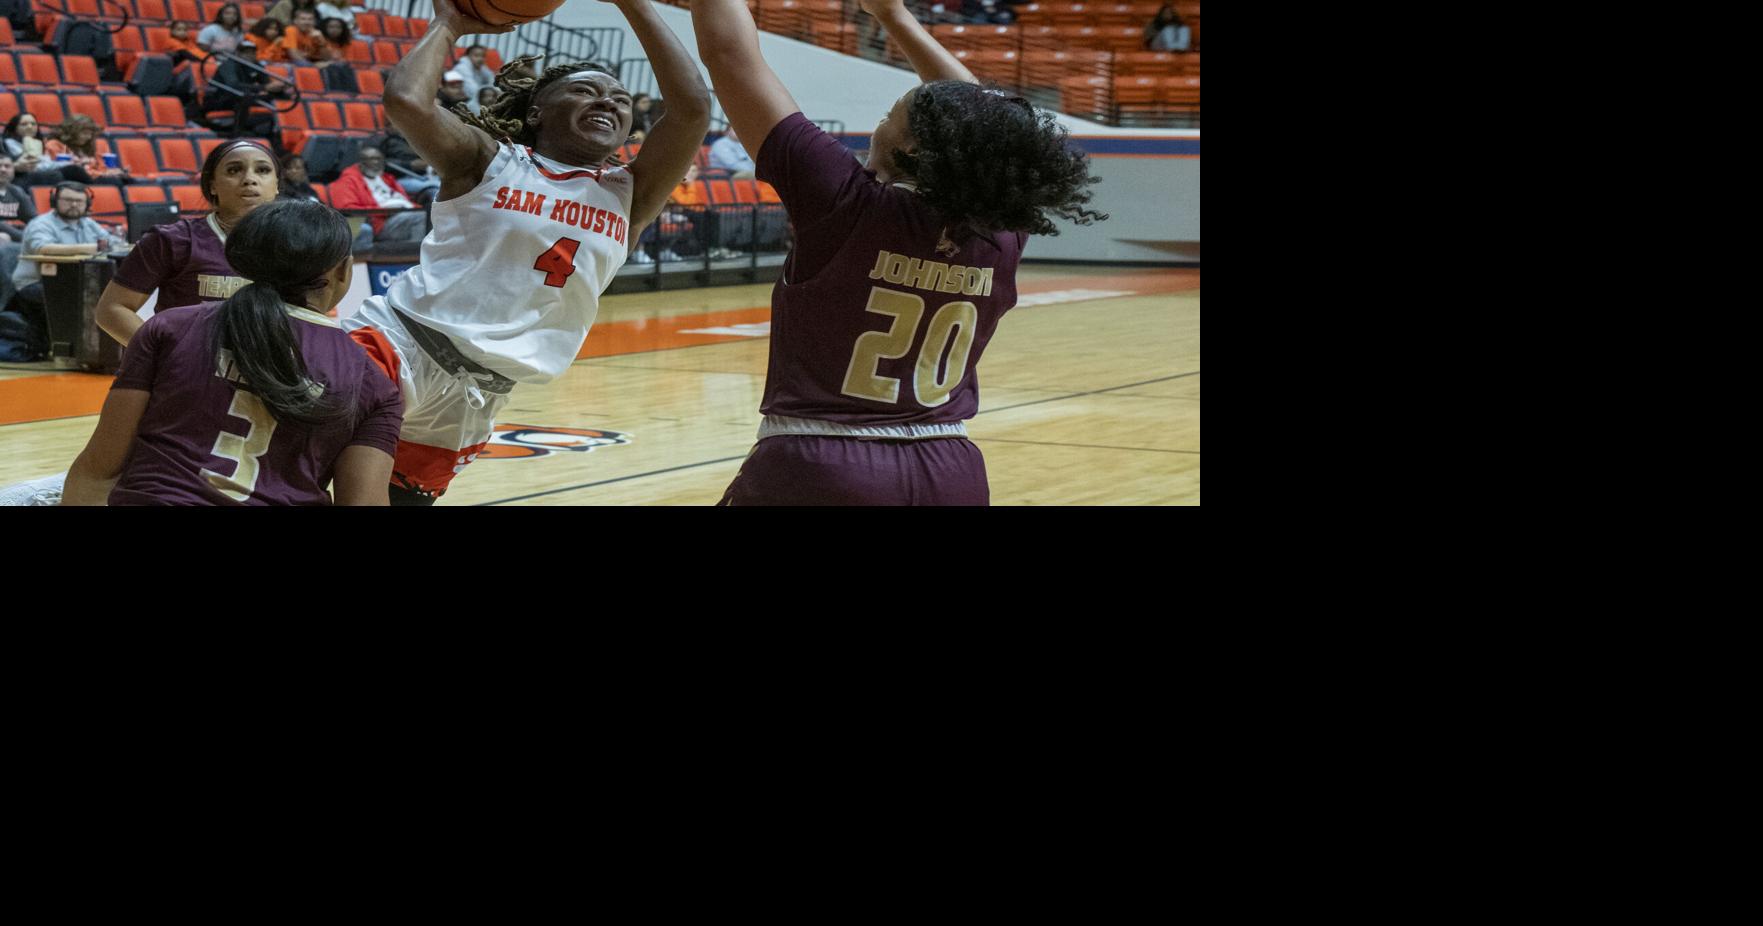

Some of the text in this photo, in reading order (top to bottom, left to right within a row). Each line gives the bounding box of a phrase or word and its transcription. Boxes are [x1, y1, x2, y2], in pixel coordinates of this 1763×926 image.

[492, 186, 628, 247] SAM HOUSTON
[197, 274, 255, 299] TEXA
[533, 236, 581, 288] 4
[868, 249, 994, 297] JOHNSON
[840, 286, 978, 408] 20
[200, 388, 278, 502] 3
